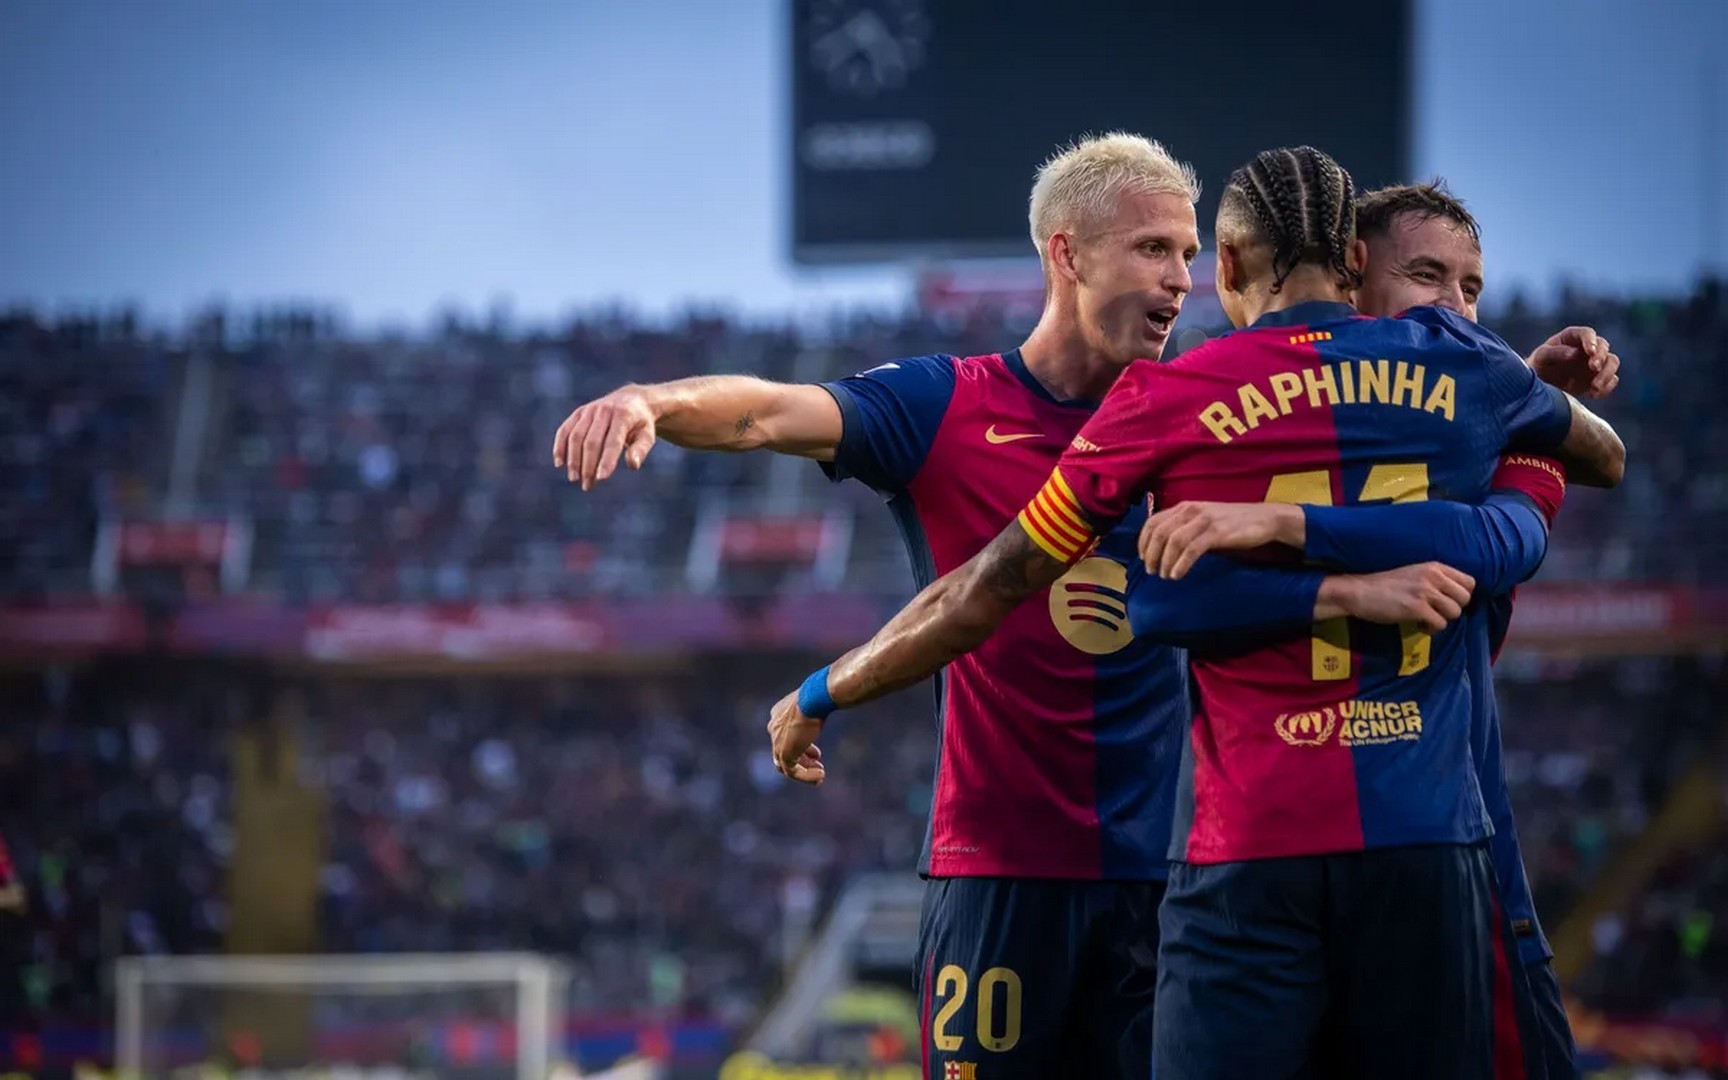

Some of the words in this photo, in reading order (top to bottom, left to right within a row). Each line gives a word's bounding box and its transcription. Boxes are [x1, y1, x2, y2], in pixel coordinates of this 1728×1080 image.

[1199, 360, 1455, 444] RAPHINHA
[1338, 700, 1420, 720] UNHCR
[1338, 715, 1422, 739] ACNUR
[933, 964, 1022, 1052] 20
